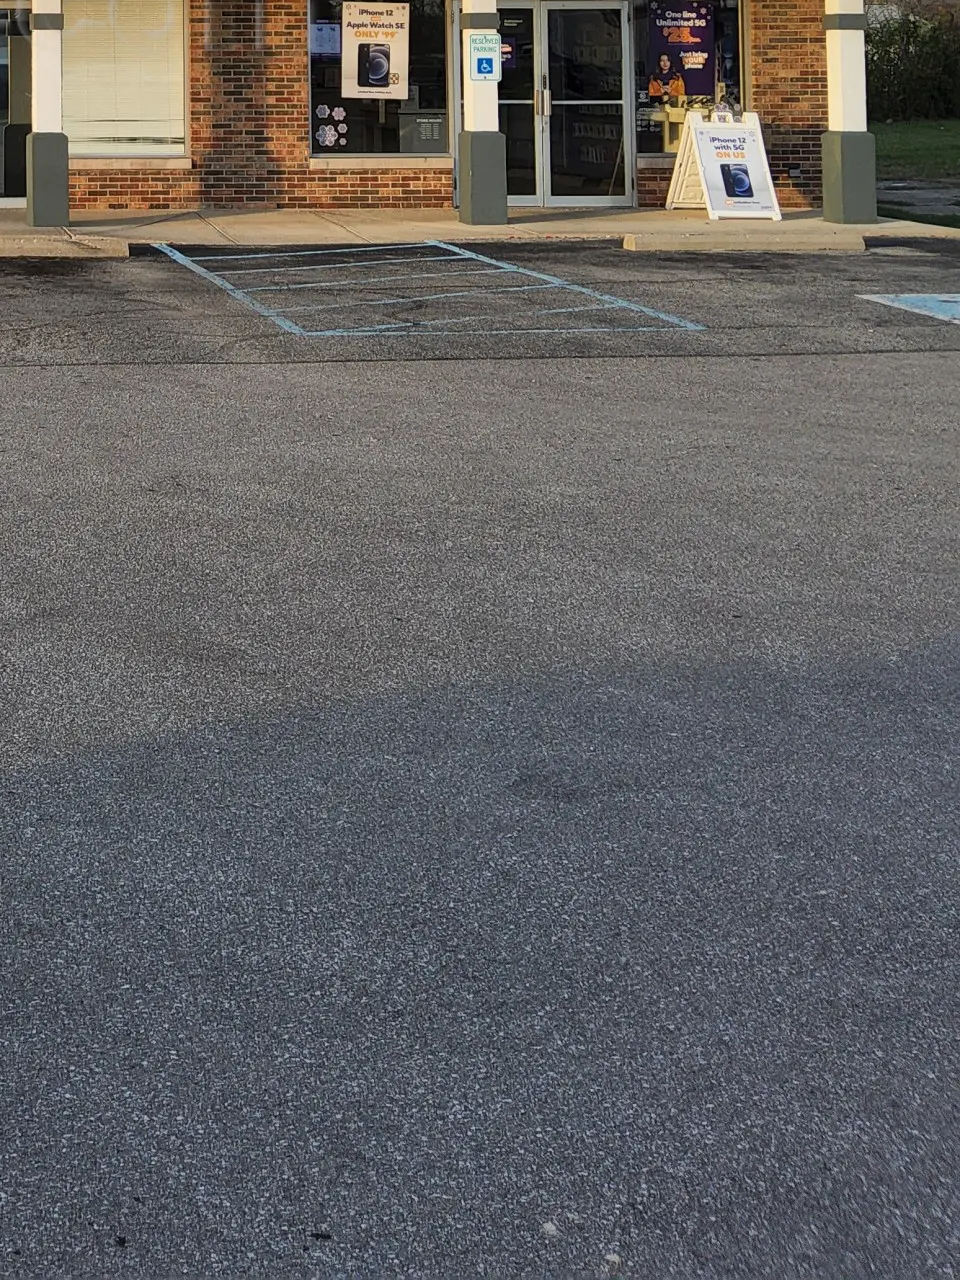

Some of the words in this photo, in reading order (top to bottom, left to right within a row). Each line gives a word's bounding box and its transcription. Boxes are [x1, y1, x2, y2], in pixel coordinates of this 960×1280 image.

[358, 8, 385, 16] iPhone
[665, 10, 682, 18] One
[682, 10, 697, 18] line
[346, 21, 369, 30] Apple
[369, 21, 394, 29] Watch
[656, 19, 694, 27] Unlimited
[694, 19, 707, 27] 5G
[354, 30, 379, 39] ONLY
[471, 37, 499, 45] RESERVED
[692, 51, 709, 59] bring
[709, 136, 737, 144] iPhone
